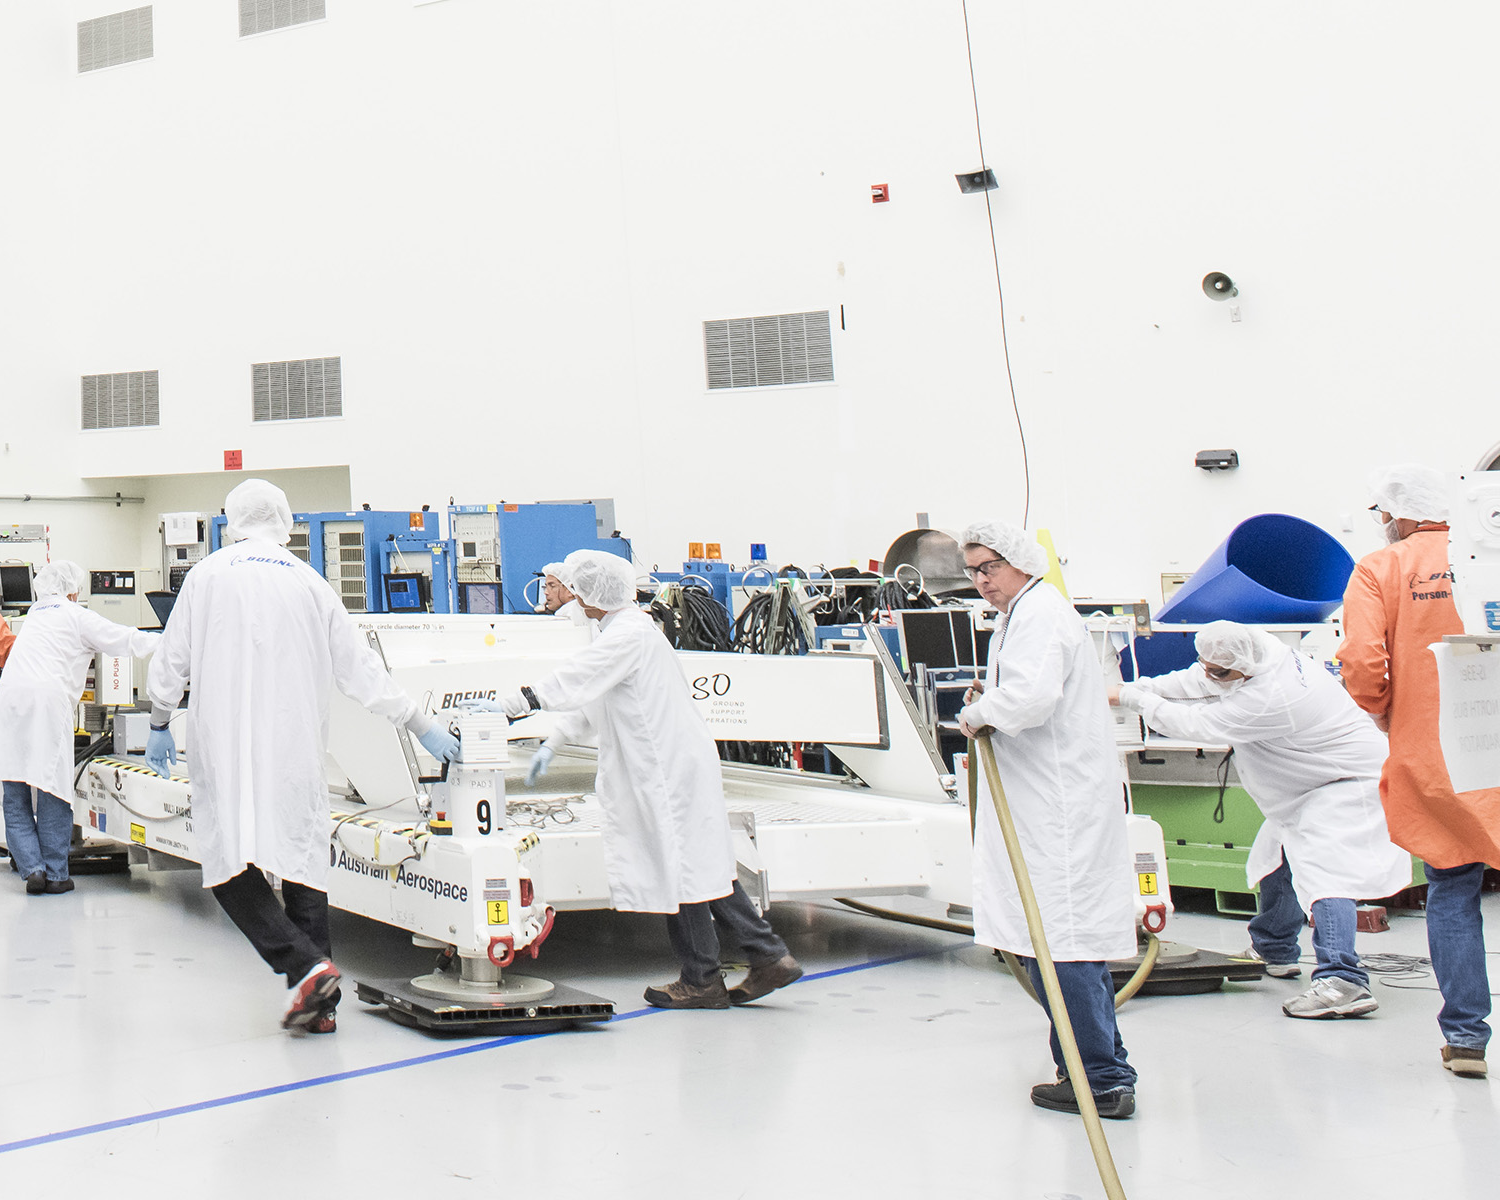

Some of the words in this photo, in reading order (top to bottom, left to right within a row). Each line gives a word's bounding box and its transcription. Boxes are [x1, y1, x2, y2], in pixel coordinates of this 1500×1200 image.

[113, 679, 119, 690] NO
[692, 673, 731, 700] SO
[476, 799, 492, 835] 9
[396, 863, 468, 902] Aerospace
